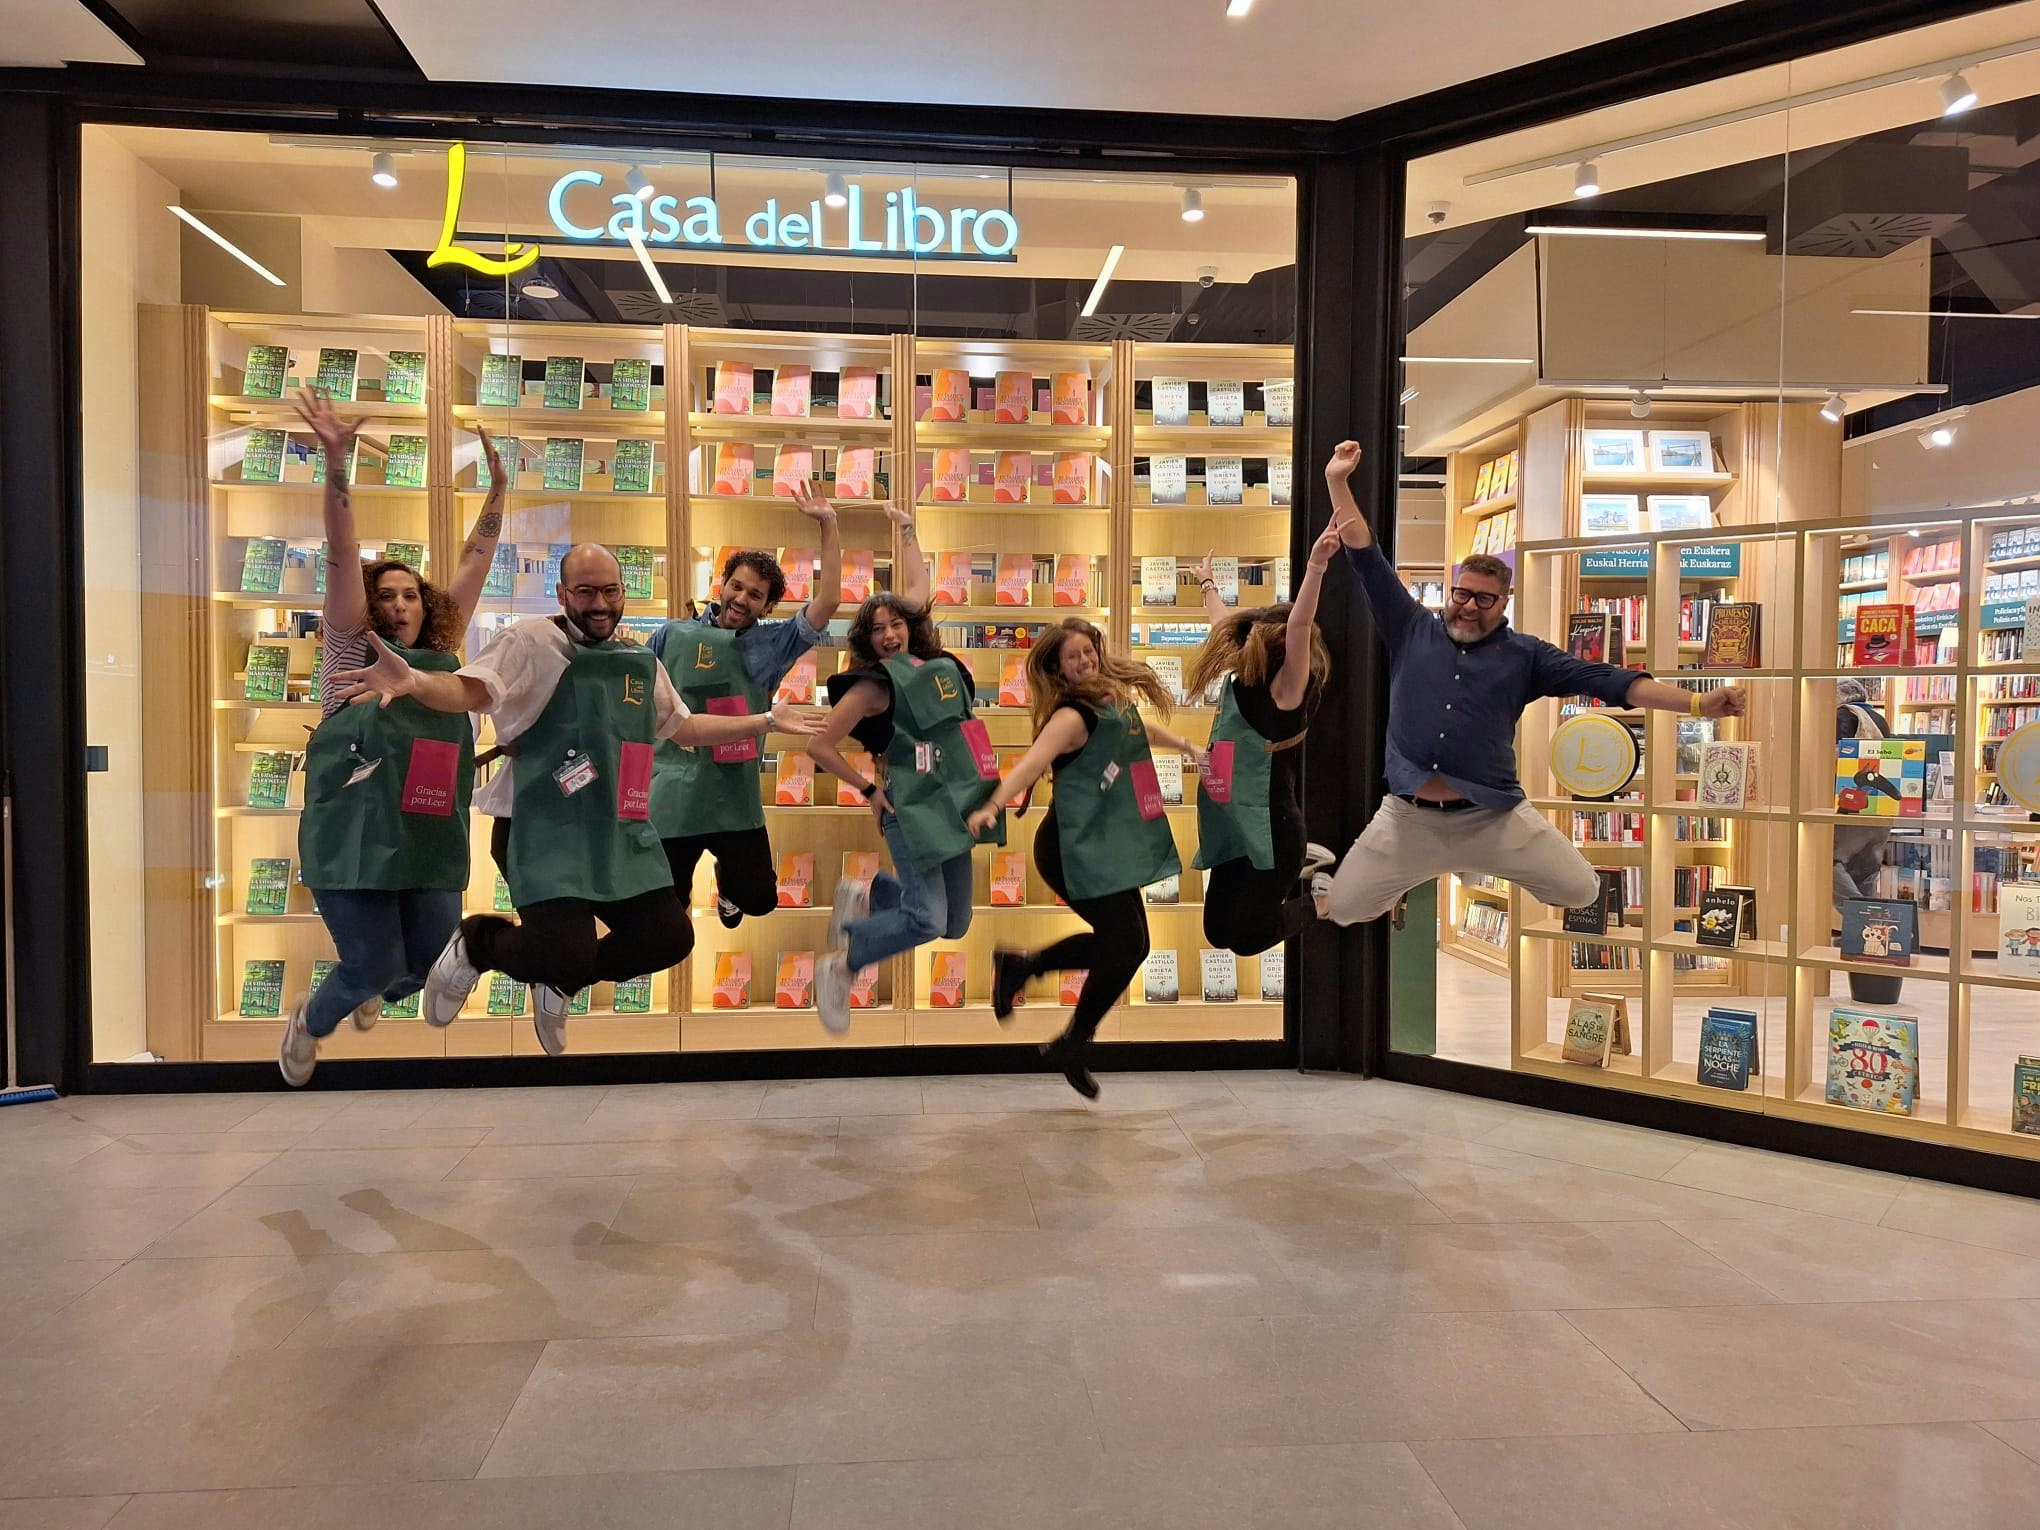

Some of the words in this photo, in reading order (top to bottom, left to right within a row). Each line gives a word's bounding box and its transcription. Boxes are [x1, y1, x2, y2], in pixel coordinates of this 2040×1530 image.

[427, 142, 540, 276] L
[547, 170, 724, 243] Casa
[744, 199, 821, 247] del
[849, 184, 1019, 256] Libro
[1694, 546, 1731, 556] Euskera
[1586, 558, 1616, 568] Euskal
[1689, 559, 1732, 568] Euskaraz
[1860, 617, 1897, 633] CACA
[1570, 624, 1603, 640] Keeping
[695, 642, 716, 669] L
[623, 674, 645, 705] L
[934, 675, 958, 701] L
[720, 745, 733, 755] por
[416, 786, 447, 796] Gracias
[410, 797, 426, 806] por
[428, 797, 446, 807] Leer
[624, 800, 635, 810] por
[1706, 896, 1736, 906] anhelo
[2015, 894, 2032, 902] Nos
[1570, 907, 1594, 916] ROSAS
[1568, 915, 1598, 924] ESPINAS
[1571, 1018, 1596, 1030] ALAS
[1568, 1028, 1604, 1043] SANGRE
[1704, 1046, 1742, 1058] SERPIENTE
[1712, 1054, 1732, 1062] ALAS
[1850, 1048, 1888, 1077] 80
[1704, 1058, 1740, 1072] NOCHE
